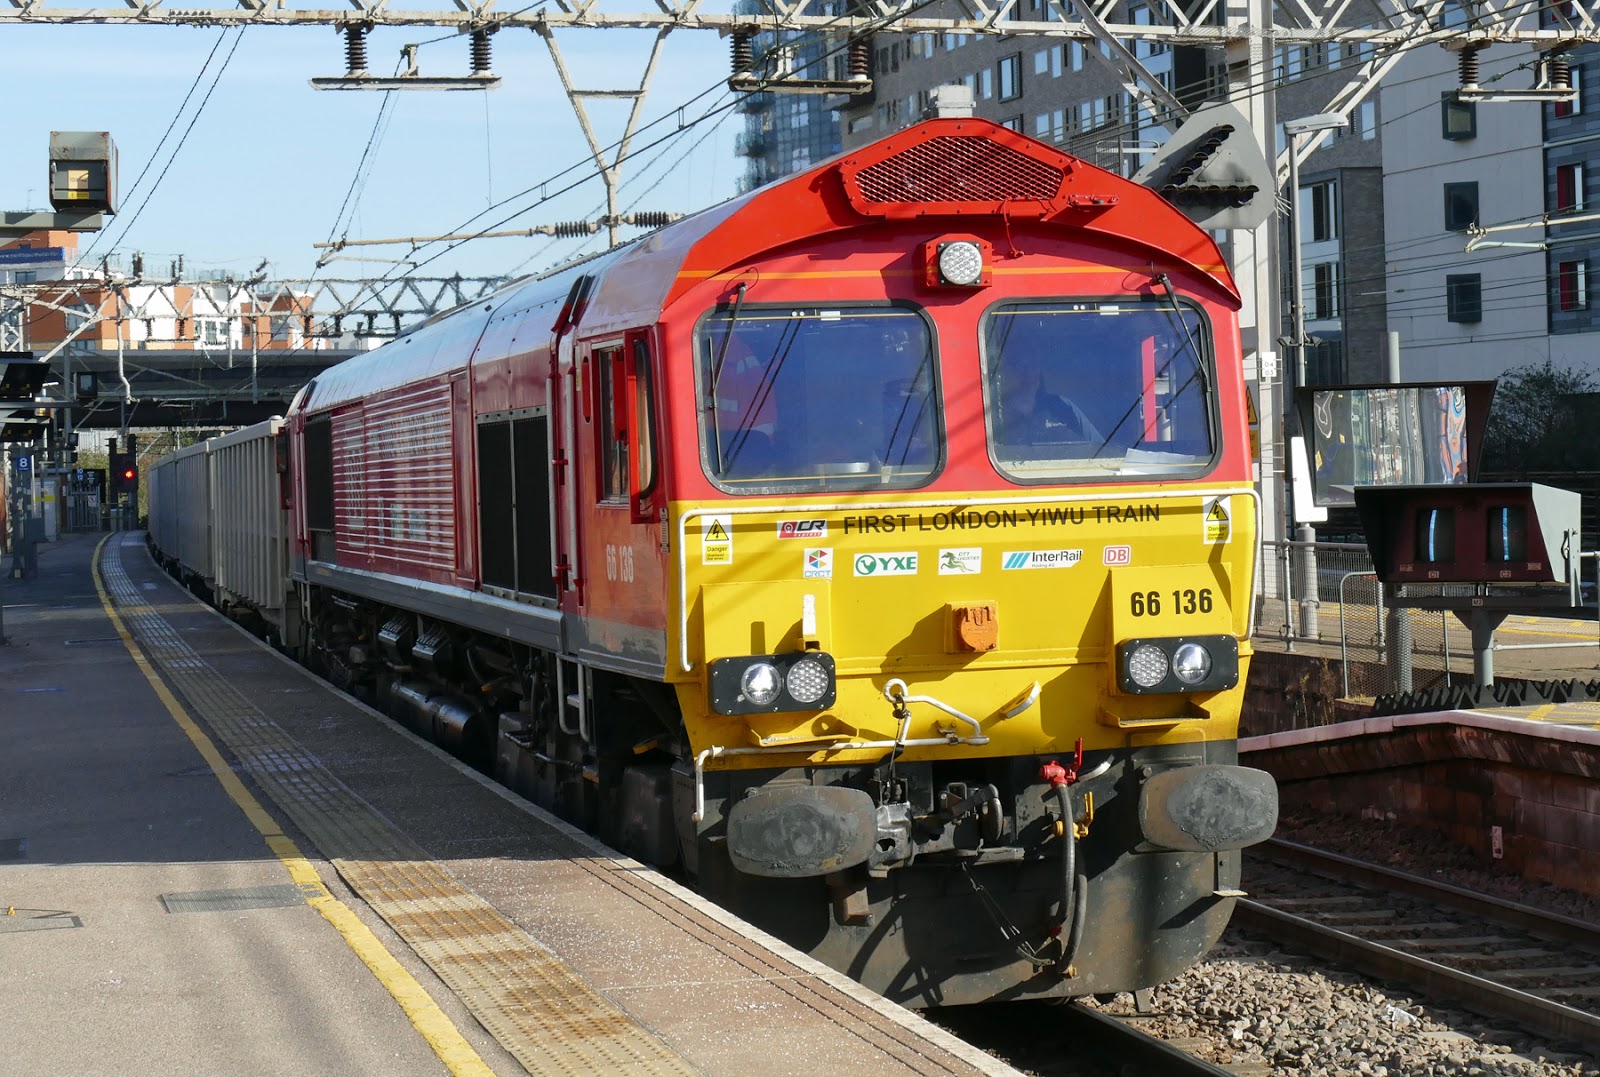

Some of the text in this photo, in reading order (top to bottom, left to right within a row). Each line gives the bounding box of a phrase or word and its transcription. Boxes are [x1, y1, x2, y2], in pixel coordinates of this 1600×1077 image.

[19, 457, 28, 467] 8
[843, 504, 1160, 535] FIRST LONDON-YIWU TRAIN
[707, 545, 728, 553] Danger
[1107, 549, 1127, 562] DB
[1032, 550, 1082, 563] InterRail
[606, 544, 634, 583] 66 136
[878, 556, 917, 571] YXE
[804, 570, 832, 578] CRCT
[1130, 588, 1213, 617] 66 136
